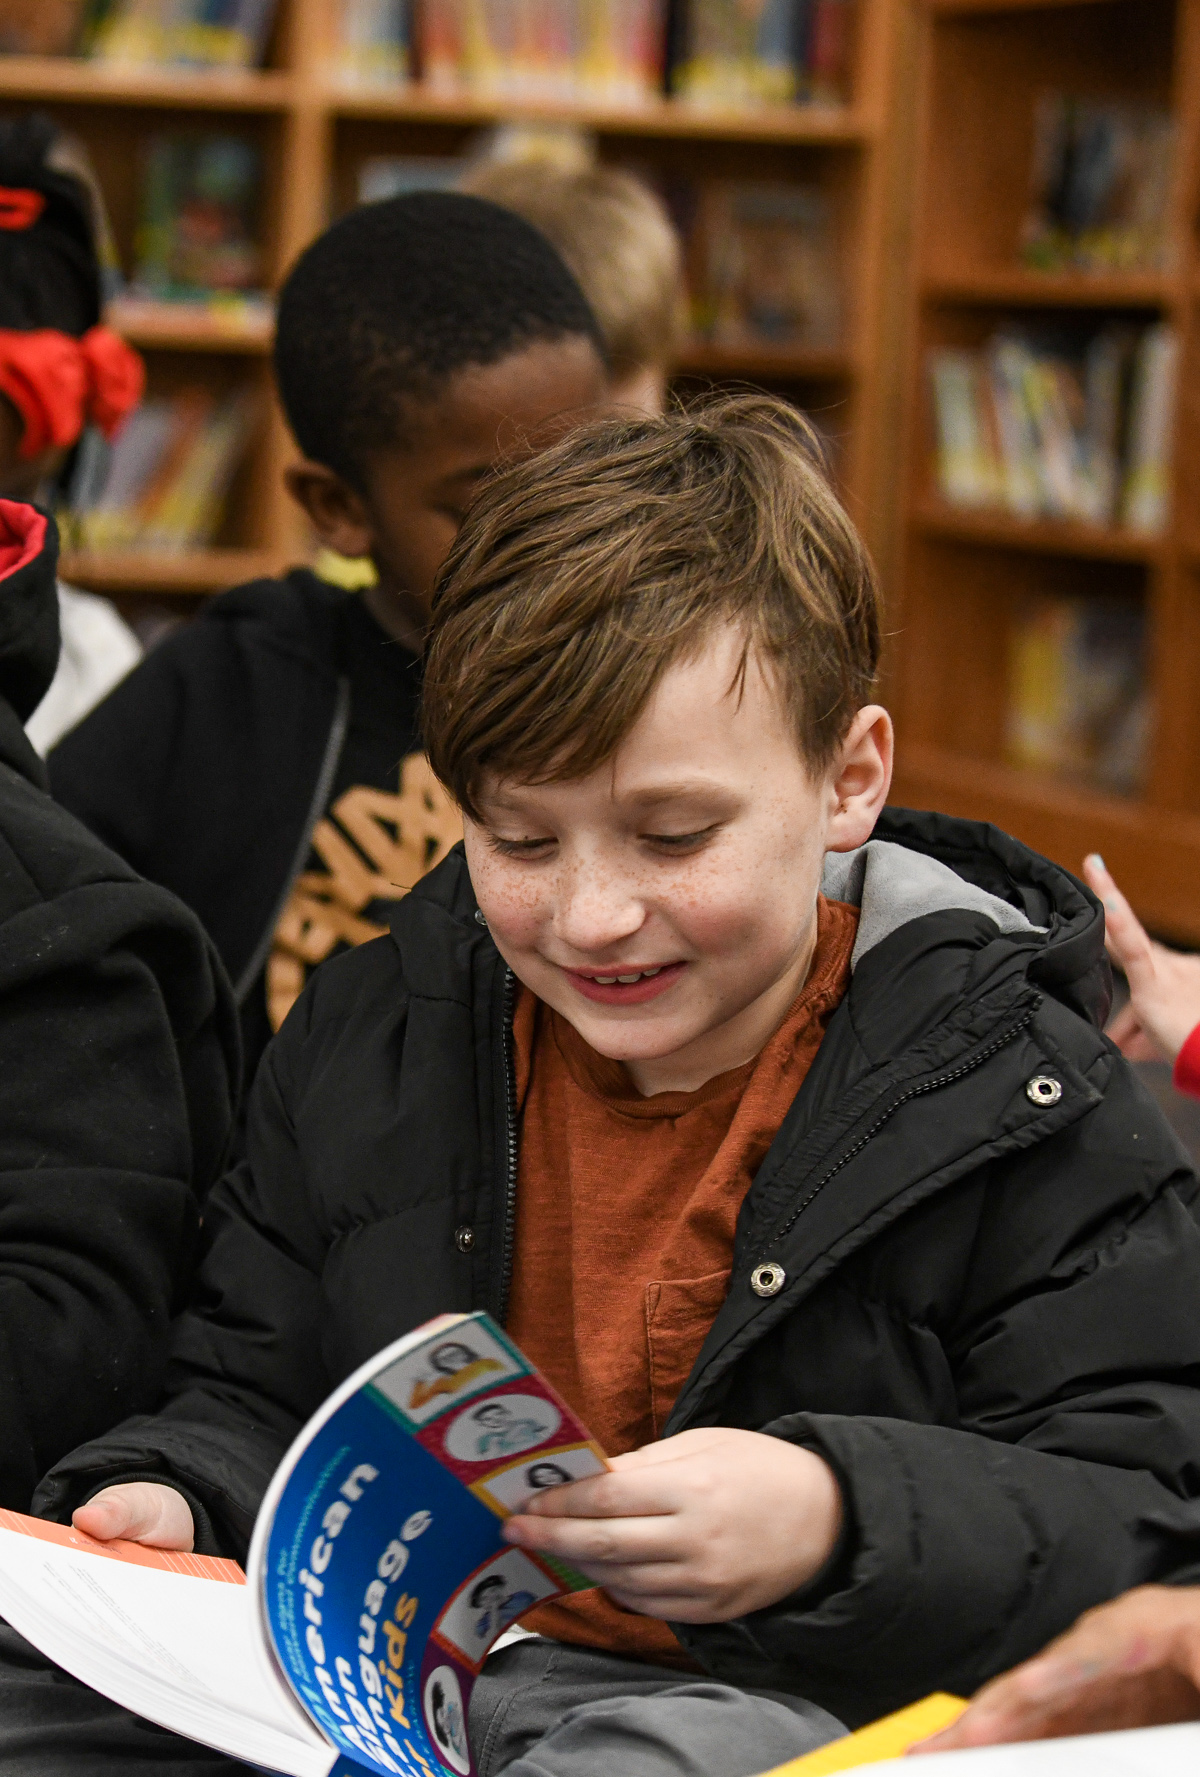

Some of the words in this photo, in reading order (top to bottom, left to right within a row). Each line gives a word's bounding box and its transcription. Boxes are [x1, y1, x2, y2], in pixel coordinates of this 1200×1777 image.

[299, 1463, 381, 1766] American
[378, 1592, 419, 1729] Kids
[300, 1684, 353, 1749] 101
